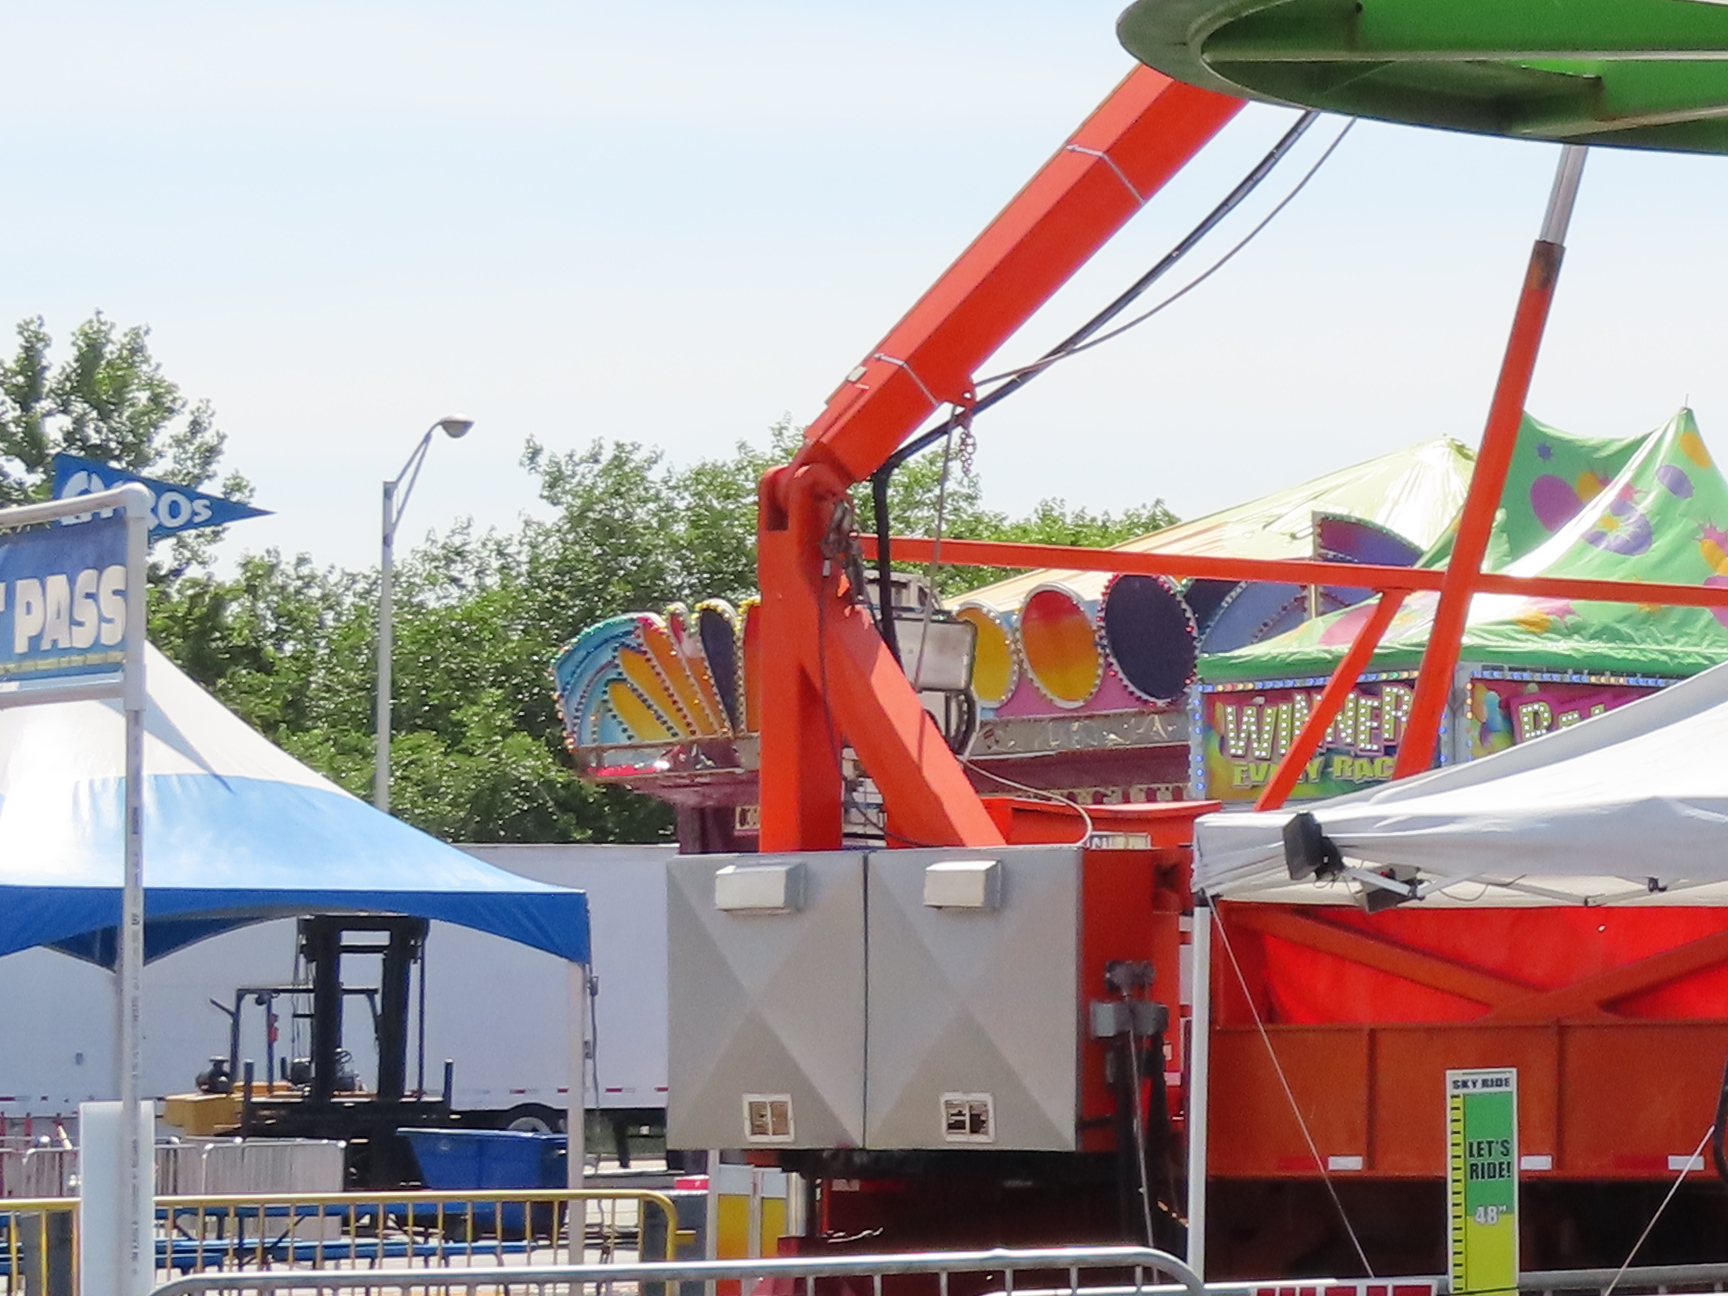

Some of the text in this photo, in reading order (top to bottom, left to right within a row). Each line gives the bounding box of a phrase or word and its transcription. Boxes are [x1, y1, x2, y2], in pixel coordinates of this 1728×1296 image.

[14, 565, 127, 655] PASS
[1233, 756, 1396, 788] EVY RAC
[1452, 1077, 1511, 1090] SKY RIDE
[1468, 1139, 1511, 1158] LET'S
[1469, 1161, 1512, 1180] RIDE!
